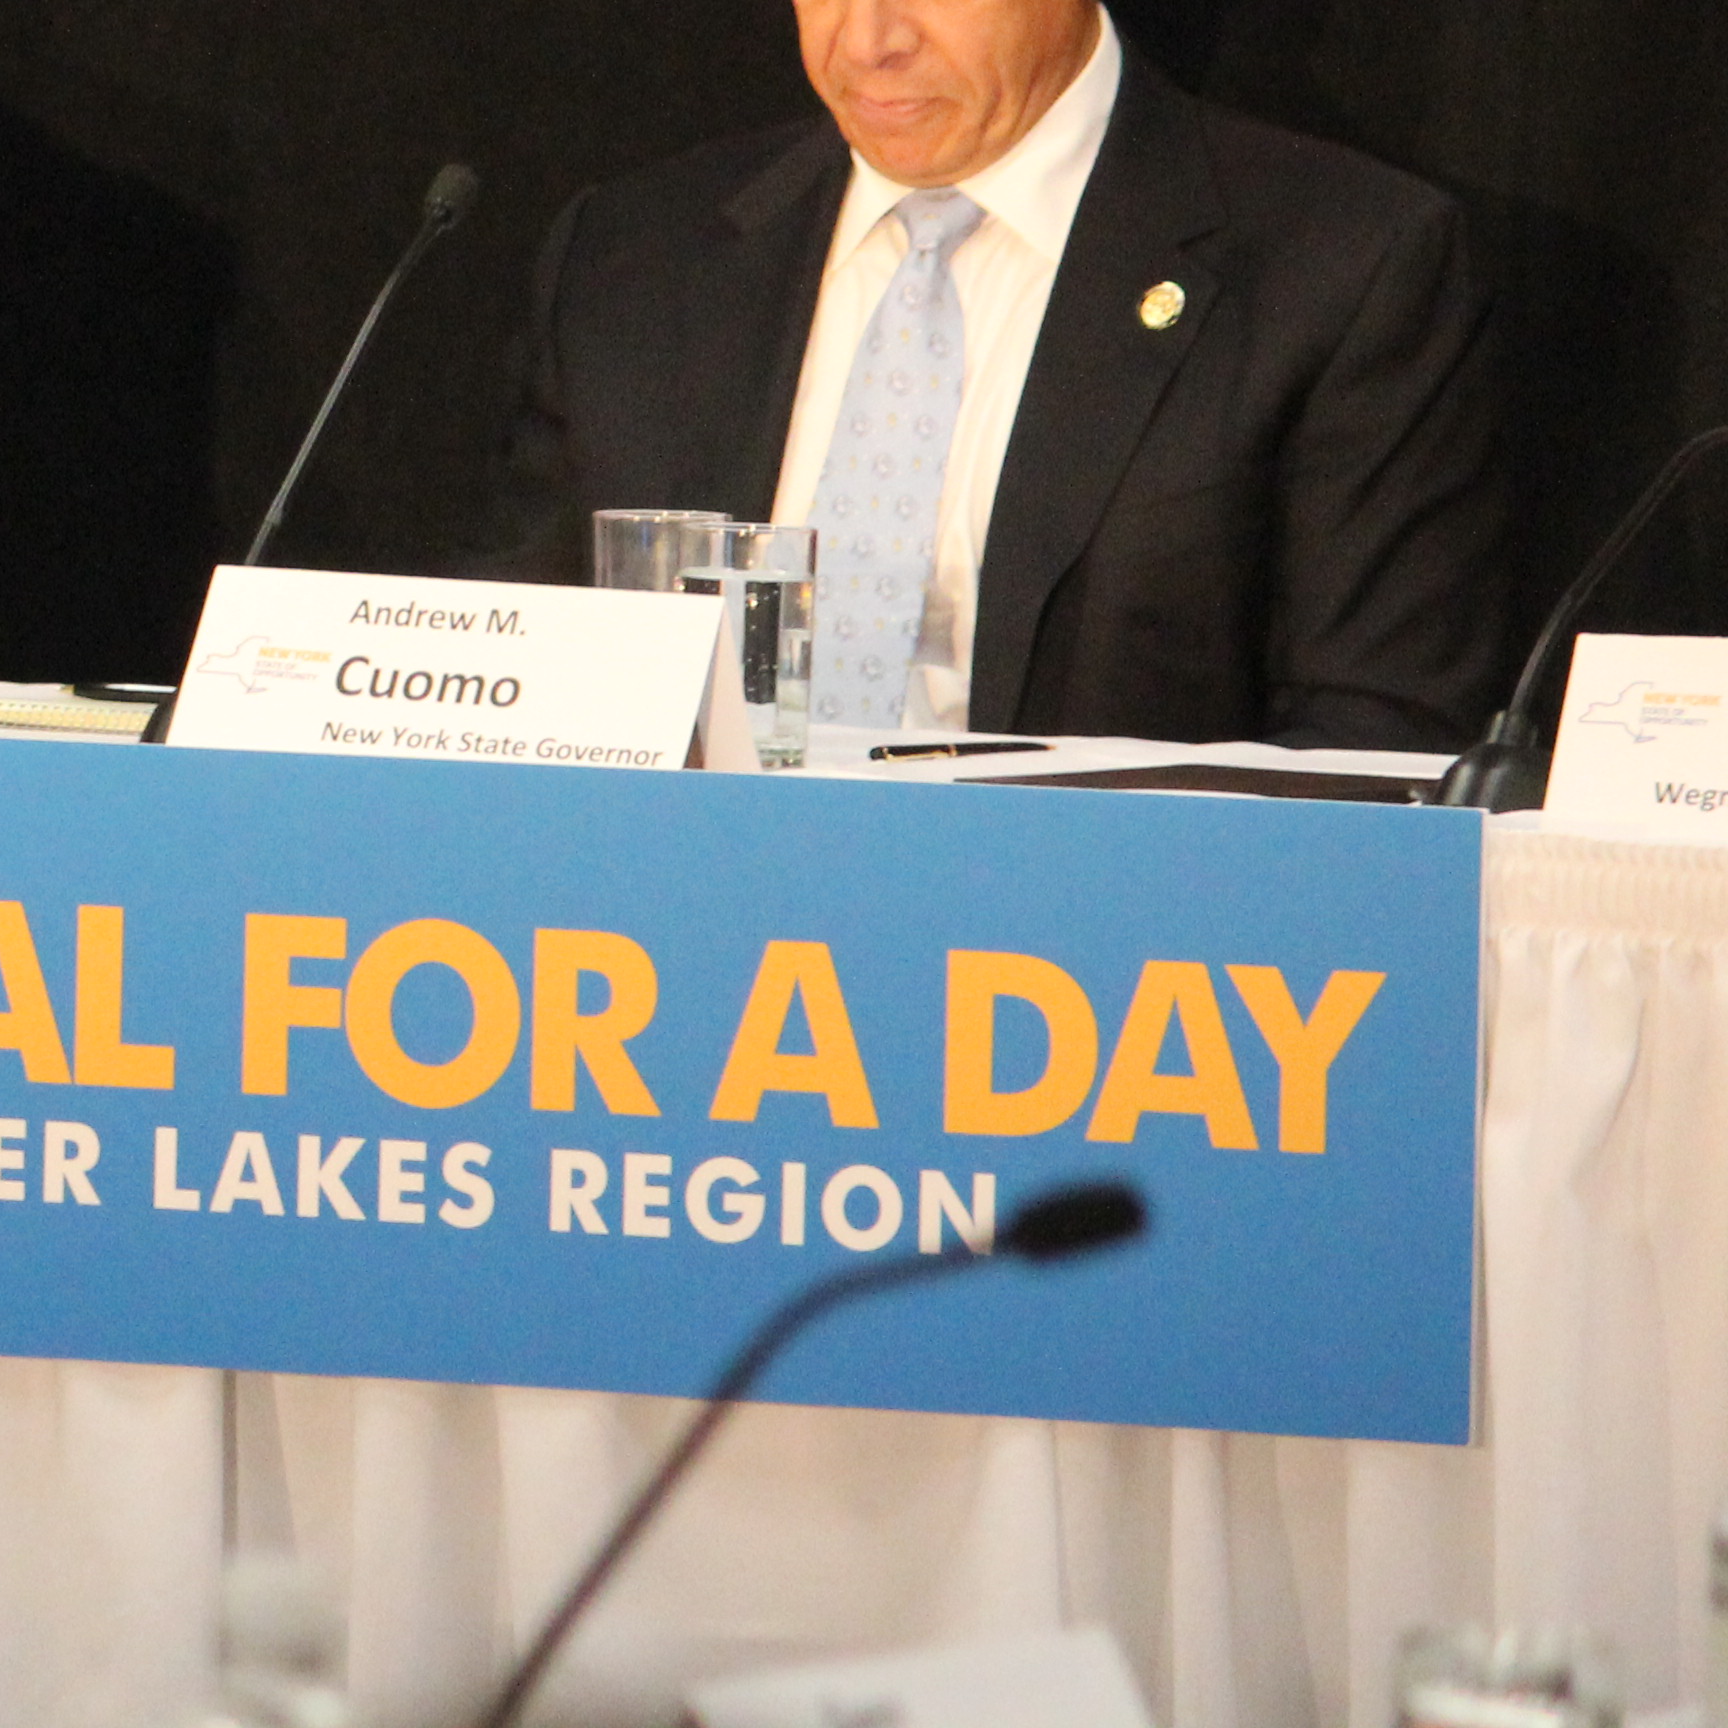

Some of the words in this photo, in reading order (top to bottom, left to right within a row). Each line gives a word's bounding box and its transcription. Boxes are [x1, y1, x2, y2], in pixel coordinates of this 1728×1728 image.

[350, 600, 476, 631] Andrew
[486, 609, 524, 635] M.
[336, 656, 520, 707] Cuomo
[322, 722, 382, 744] New
[394, 727, 449, 750] York
[458, 732, 527, 756] State
[535, 739, 663, 767] Governor
[242, 913, 661, 1116] FOR
[709, 940, 879, 1128] A
[944, 949, 1386, 1153] DAY
[154, 1127, 494, 1228] LAKES
[547, 1145, 996, 1255] REGION
